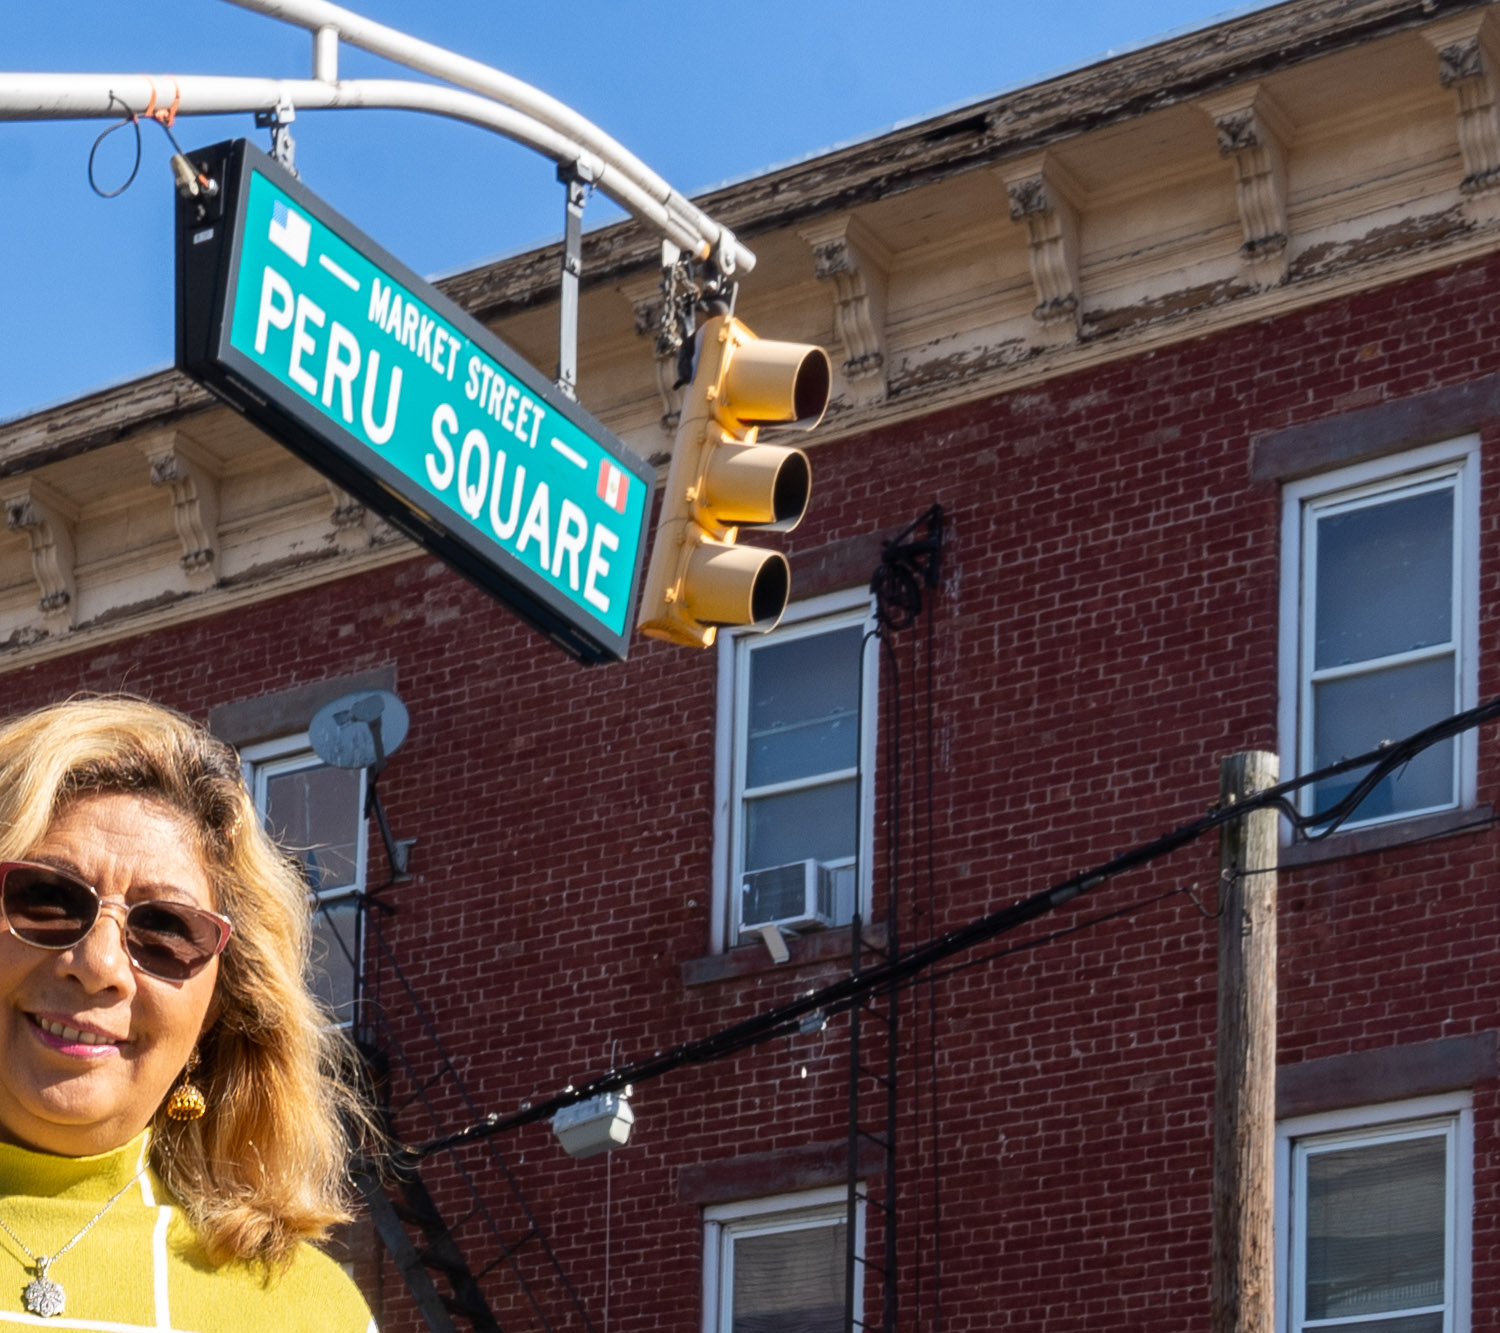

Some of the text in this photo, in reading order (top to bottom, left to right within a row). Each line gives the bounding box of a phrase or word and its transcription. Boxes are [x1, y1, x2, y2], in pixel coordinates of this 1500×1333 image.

[254, 265, 620, 614] PERU SQUARE
[367, 277, 546, 449] MARKET STREET
